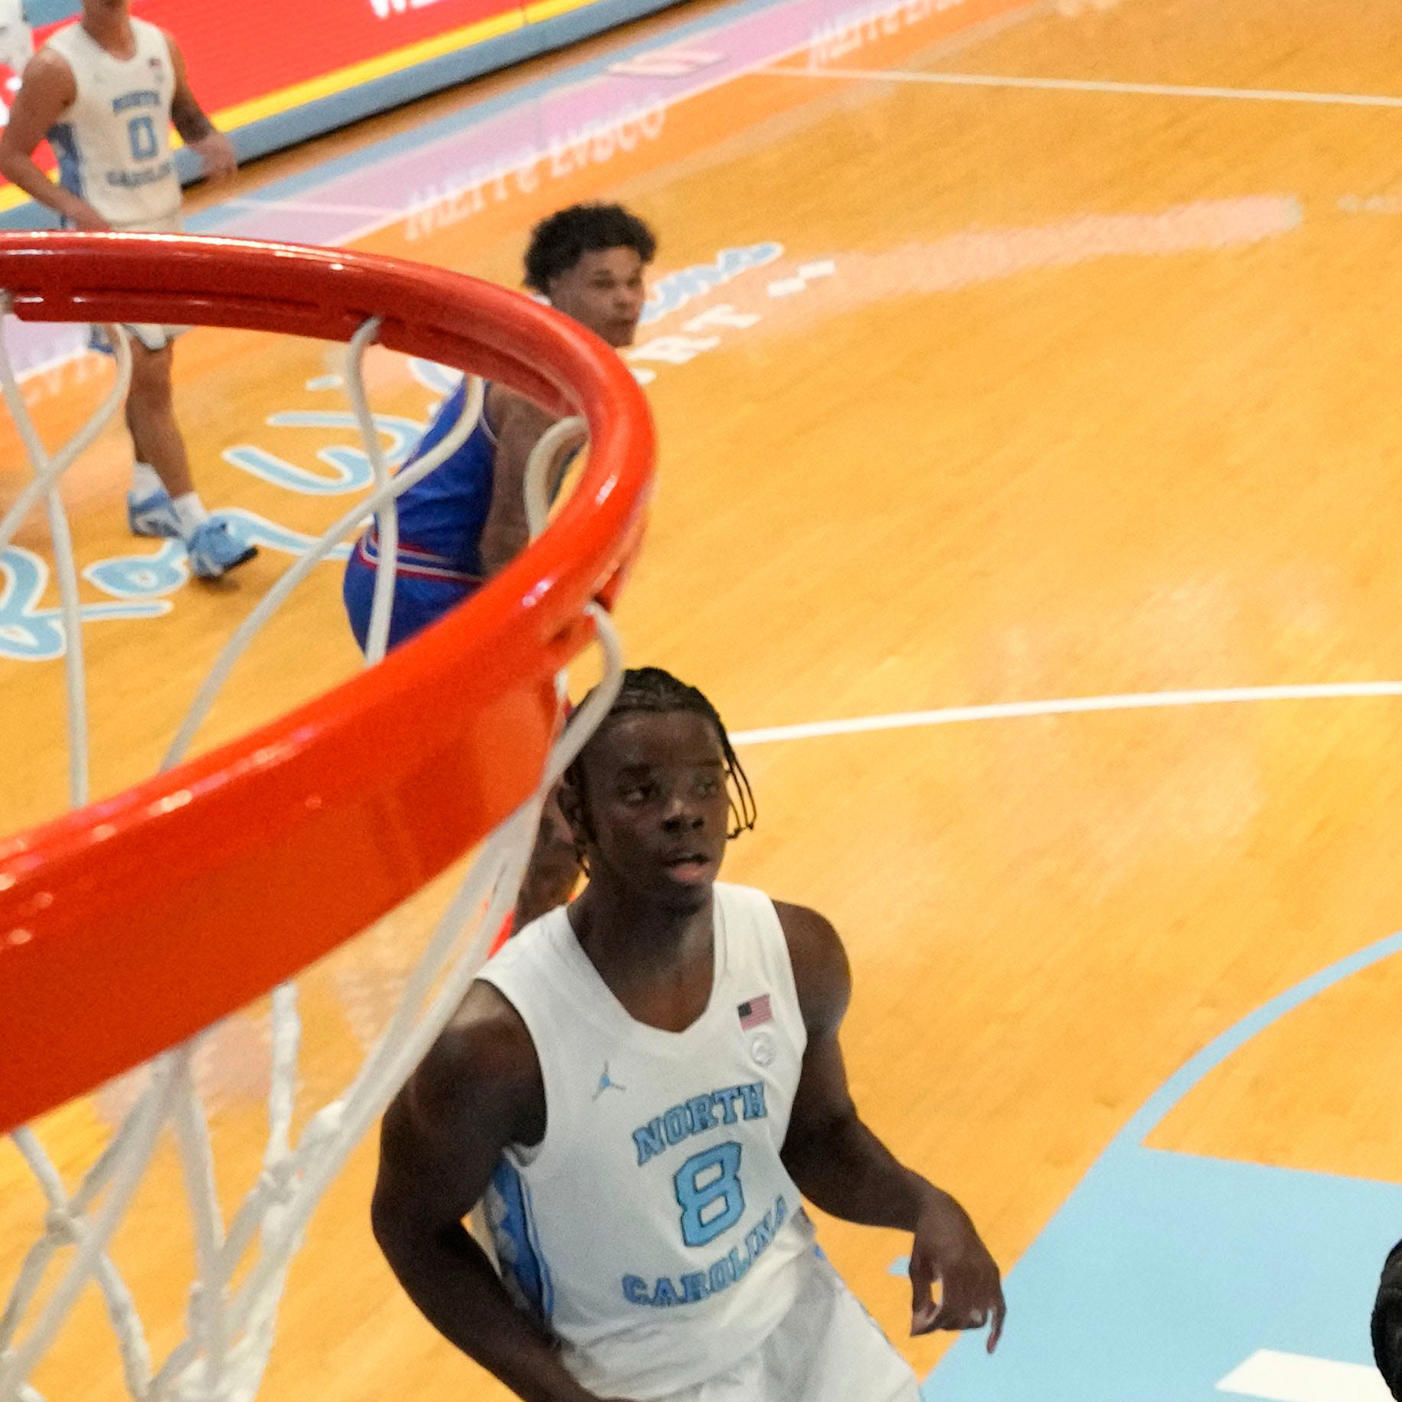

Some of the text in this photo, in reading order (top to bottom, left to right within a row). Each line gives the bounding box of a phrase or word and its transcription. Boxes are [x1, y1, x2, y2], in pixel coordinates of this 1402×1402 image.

[127, 114, 159, 161] 0
[632, 1082, 767, 1165] NORTH
[674, 1141, 745, 1247] 8
[621, 1194, 788, 1308] CAROLINA
